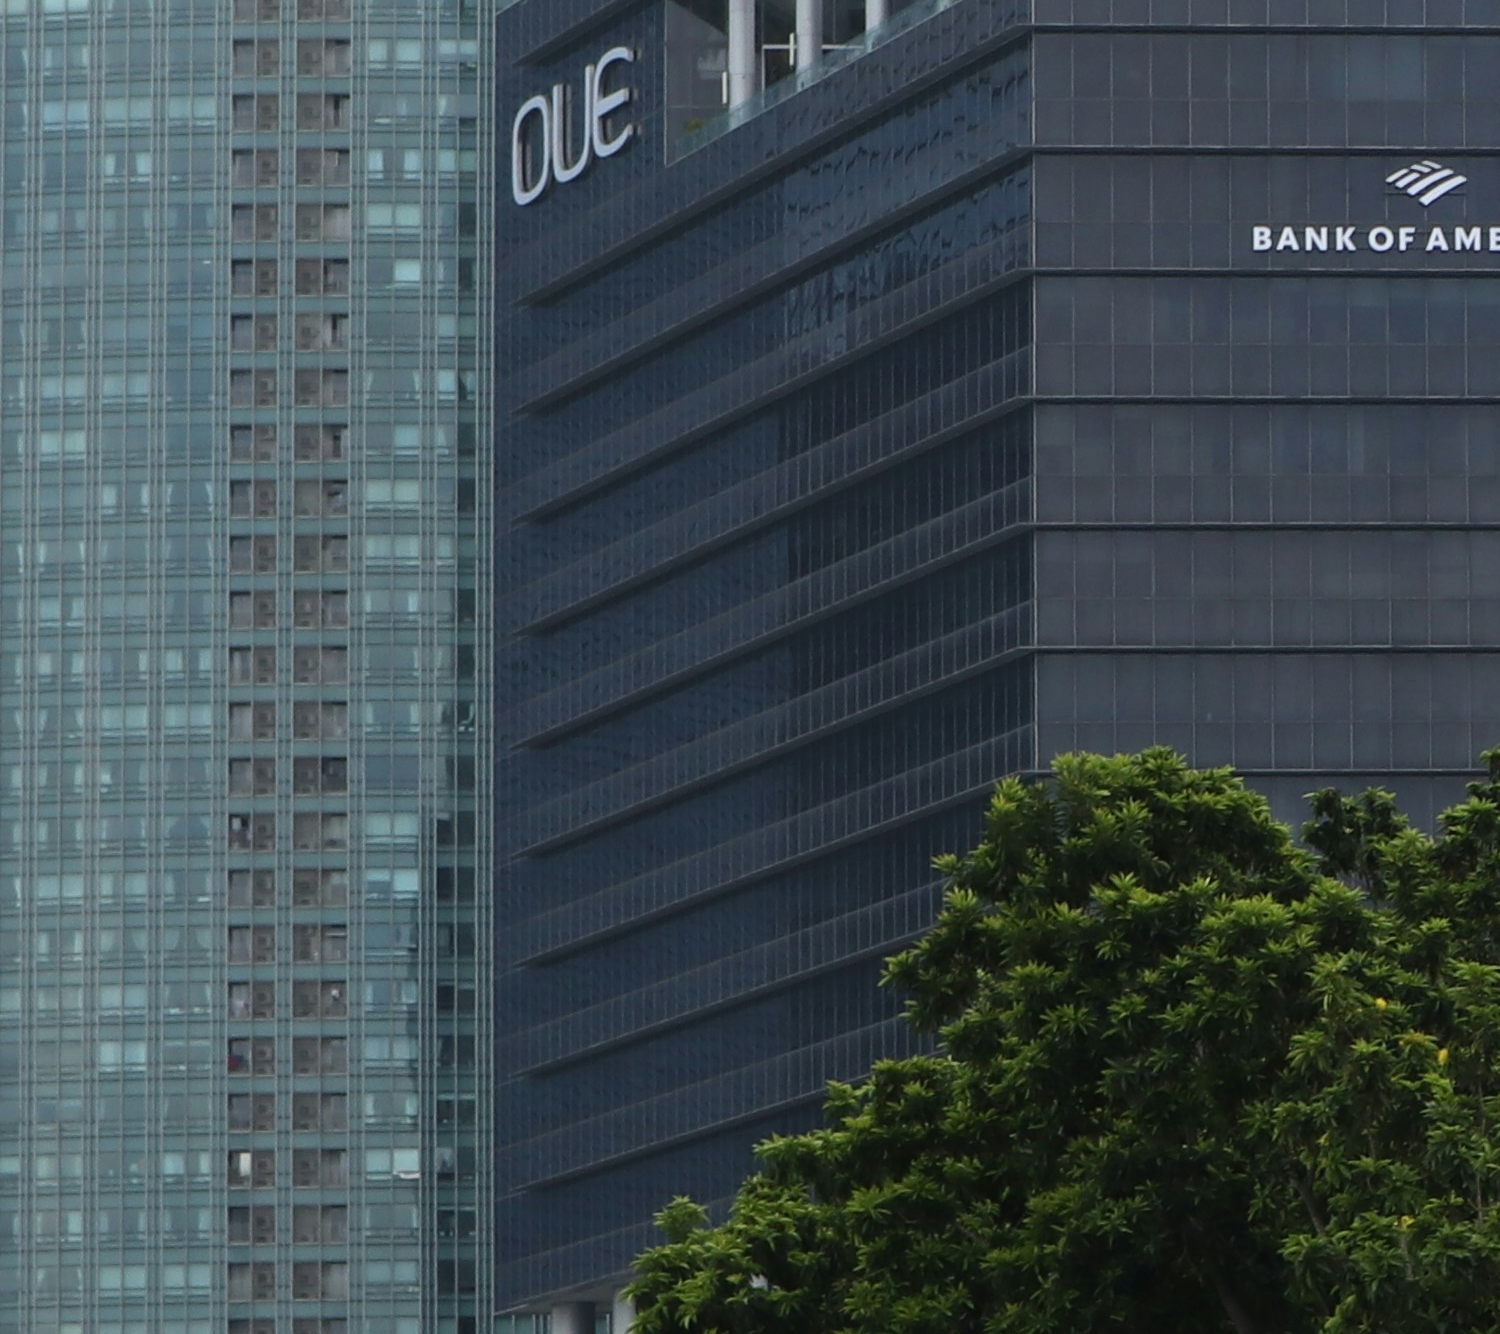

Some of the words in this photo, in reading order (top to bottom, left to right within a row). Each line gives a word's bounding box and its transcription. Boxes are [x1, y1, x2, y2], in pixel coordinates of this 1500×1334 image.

[512, 46, 637, 205] OUE
[1252, 226, 1357, 252] BANK
[1367, 226, 1417, 253] OF
